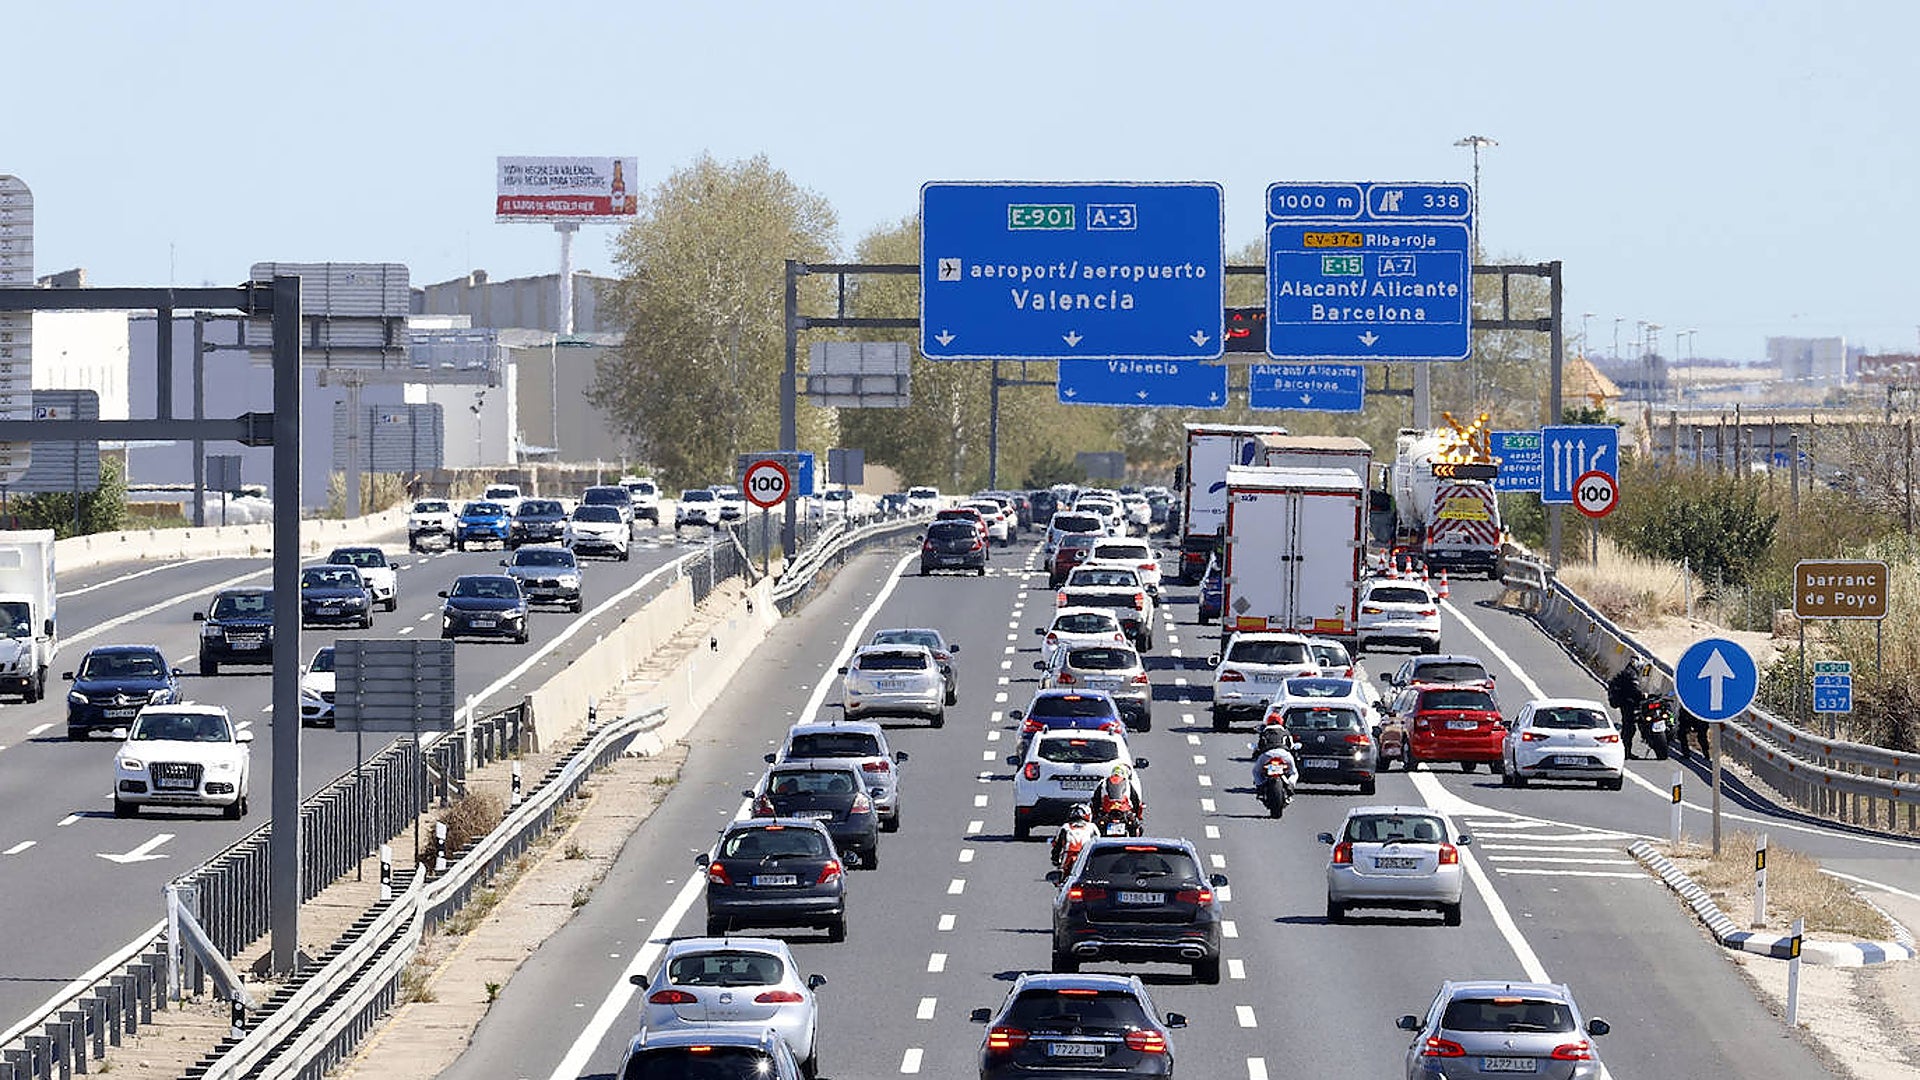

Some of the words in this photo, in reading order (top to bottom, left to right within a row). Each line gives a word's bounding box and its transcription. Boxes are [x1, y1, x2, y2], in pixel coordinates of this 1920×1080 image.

[1279, 195, 1325, 208] 1000
[1338, 198, 1352, 208] m
[1424, 195, 1459, 208] 338
[1013, 209, 1070, 225] E-901
[1093, 209, 1131, 225] A-3
[1305, 235, 1361, 246] CV-374
[1366, 234, 1436, 248] Riba-roja
[1326, 259, 1359, 272] E-15
[1383, 259, 1412, 274] A-7
[1012, 289, 1133, 310] Valencia
[1312, 304, 1425, 322] Barcelona
[1108, 360, 1178, 374] Valencia
[1274, 378, 1338, 391] Barcelona
[1505, 436, 1538, 447] E-901
[750, 476, 783, 492] 100
[1580, 485, 1611, 503] 100
[1806, 573, 1876, 587] barranc
[1806, 592, 1824, 605] de
[1835, 592, 1876, 608] Poyo
[1819, 664, 1847, 672] E-901
[1824, 677, 1842, 685] A-3
[1818, 697, 1847, 709] 337
[1055, 1045, 1080, 1054] 7722
